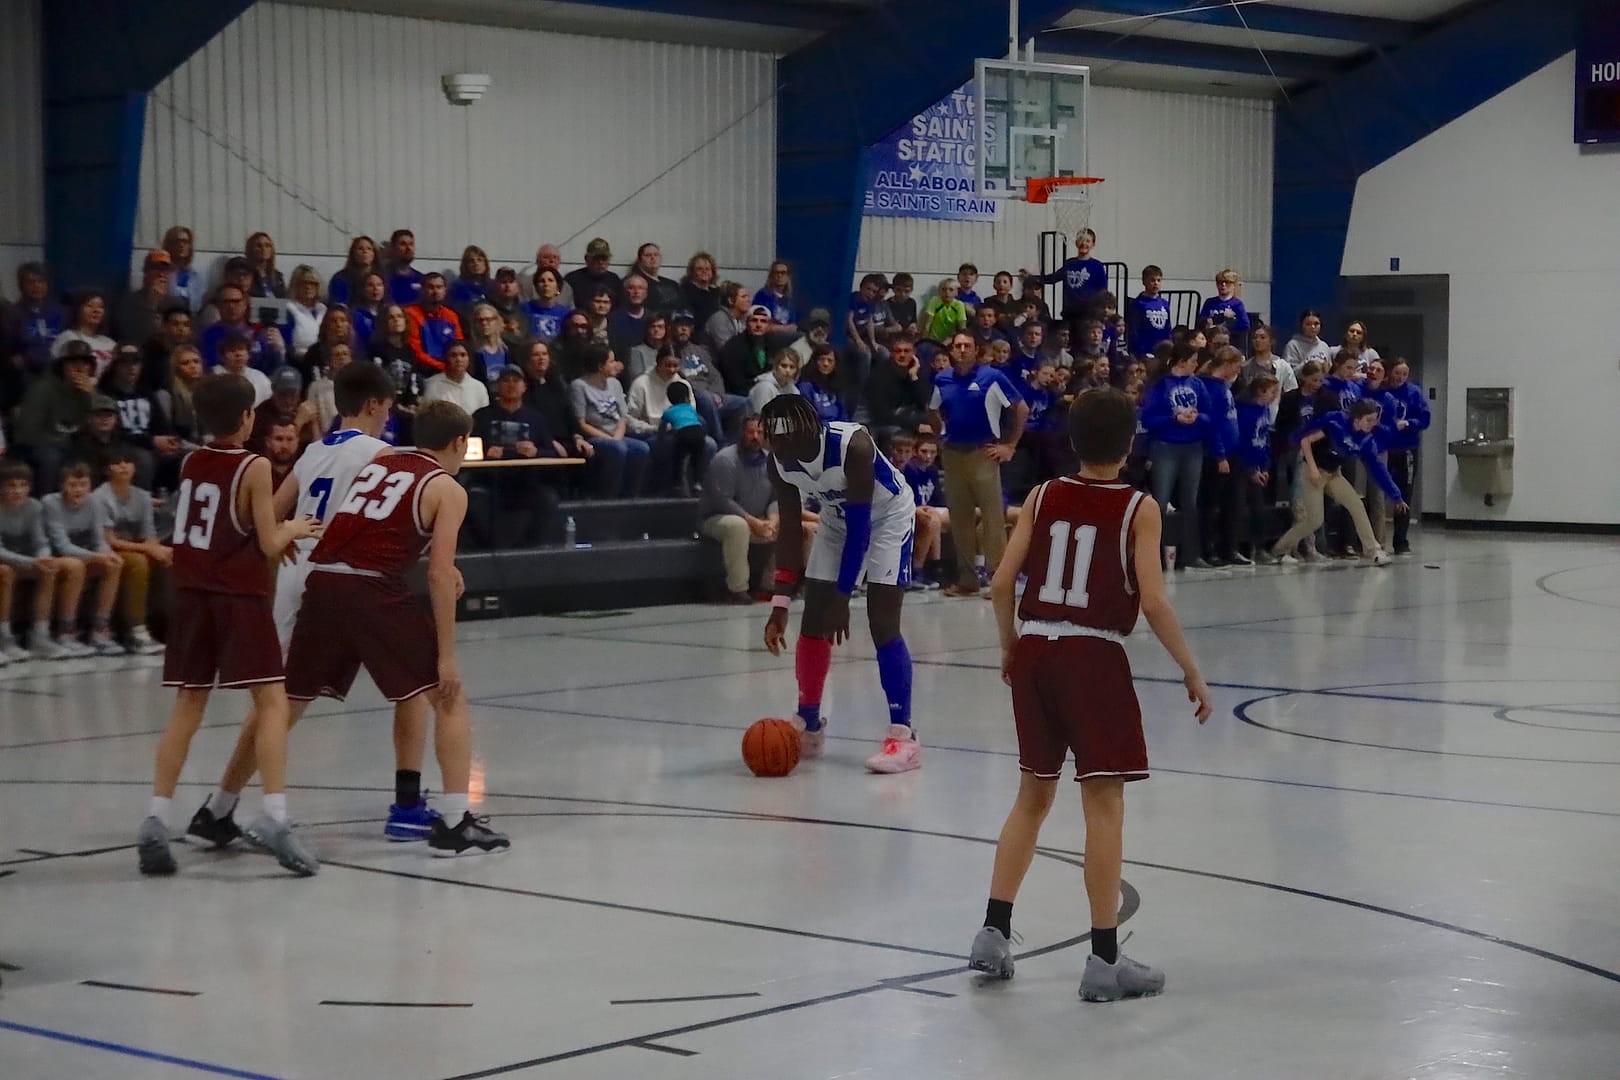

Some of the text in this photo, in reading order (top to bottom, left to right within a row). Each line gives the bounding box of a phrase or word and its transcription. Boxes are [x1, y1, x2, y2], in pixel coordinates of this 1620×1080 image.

[1592, 62, 1620, 82] HO
[877, 171, 996, 193] ALL ABOAD
[879, 193, 941, 211] SAINTS
[946, 197, 996, 214] TRAIN
[310, 477, 335, 520] 7
[339, 463, 415, 521] 23
[172, 478, 221, 550] 13
[1038, 520, 1098, 609] 11
